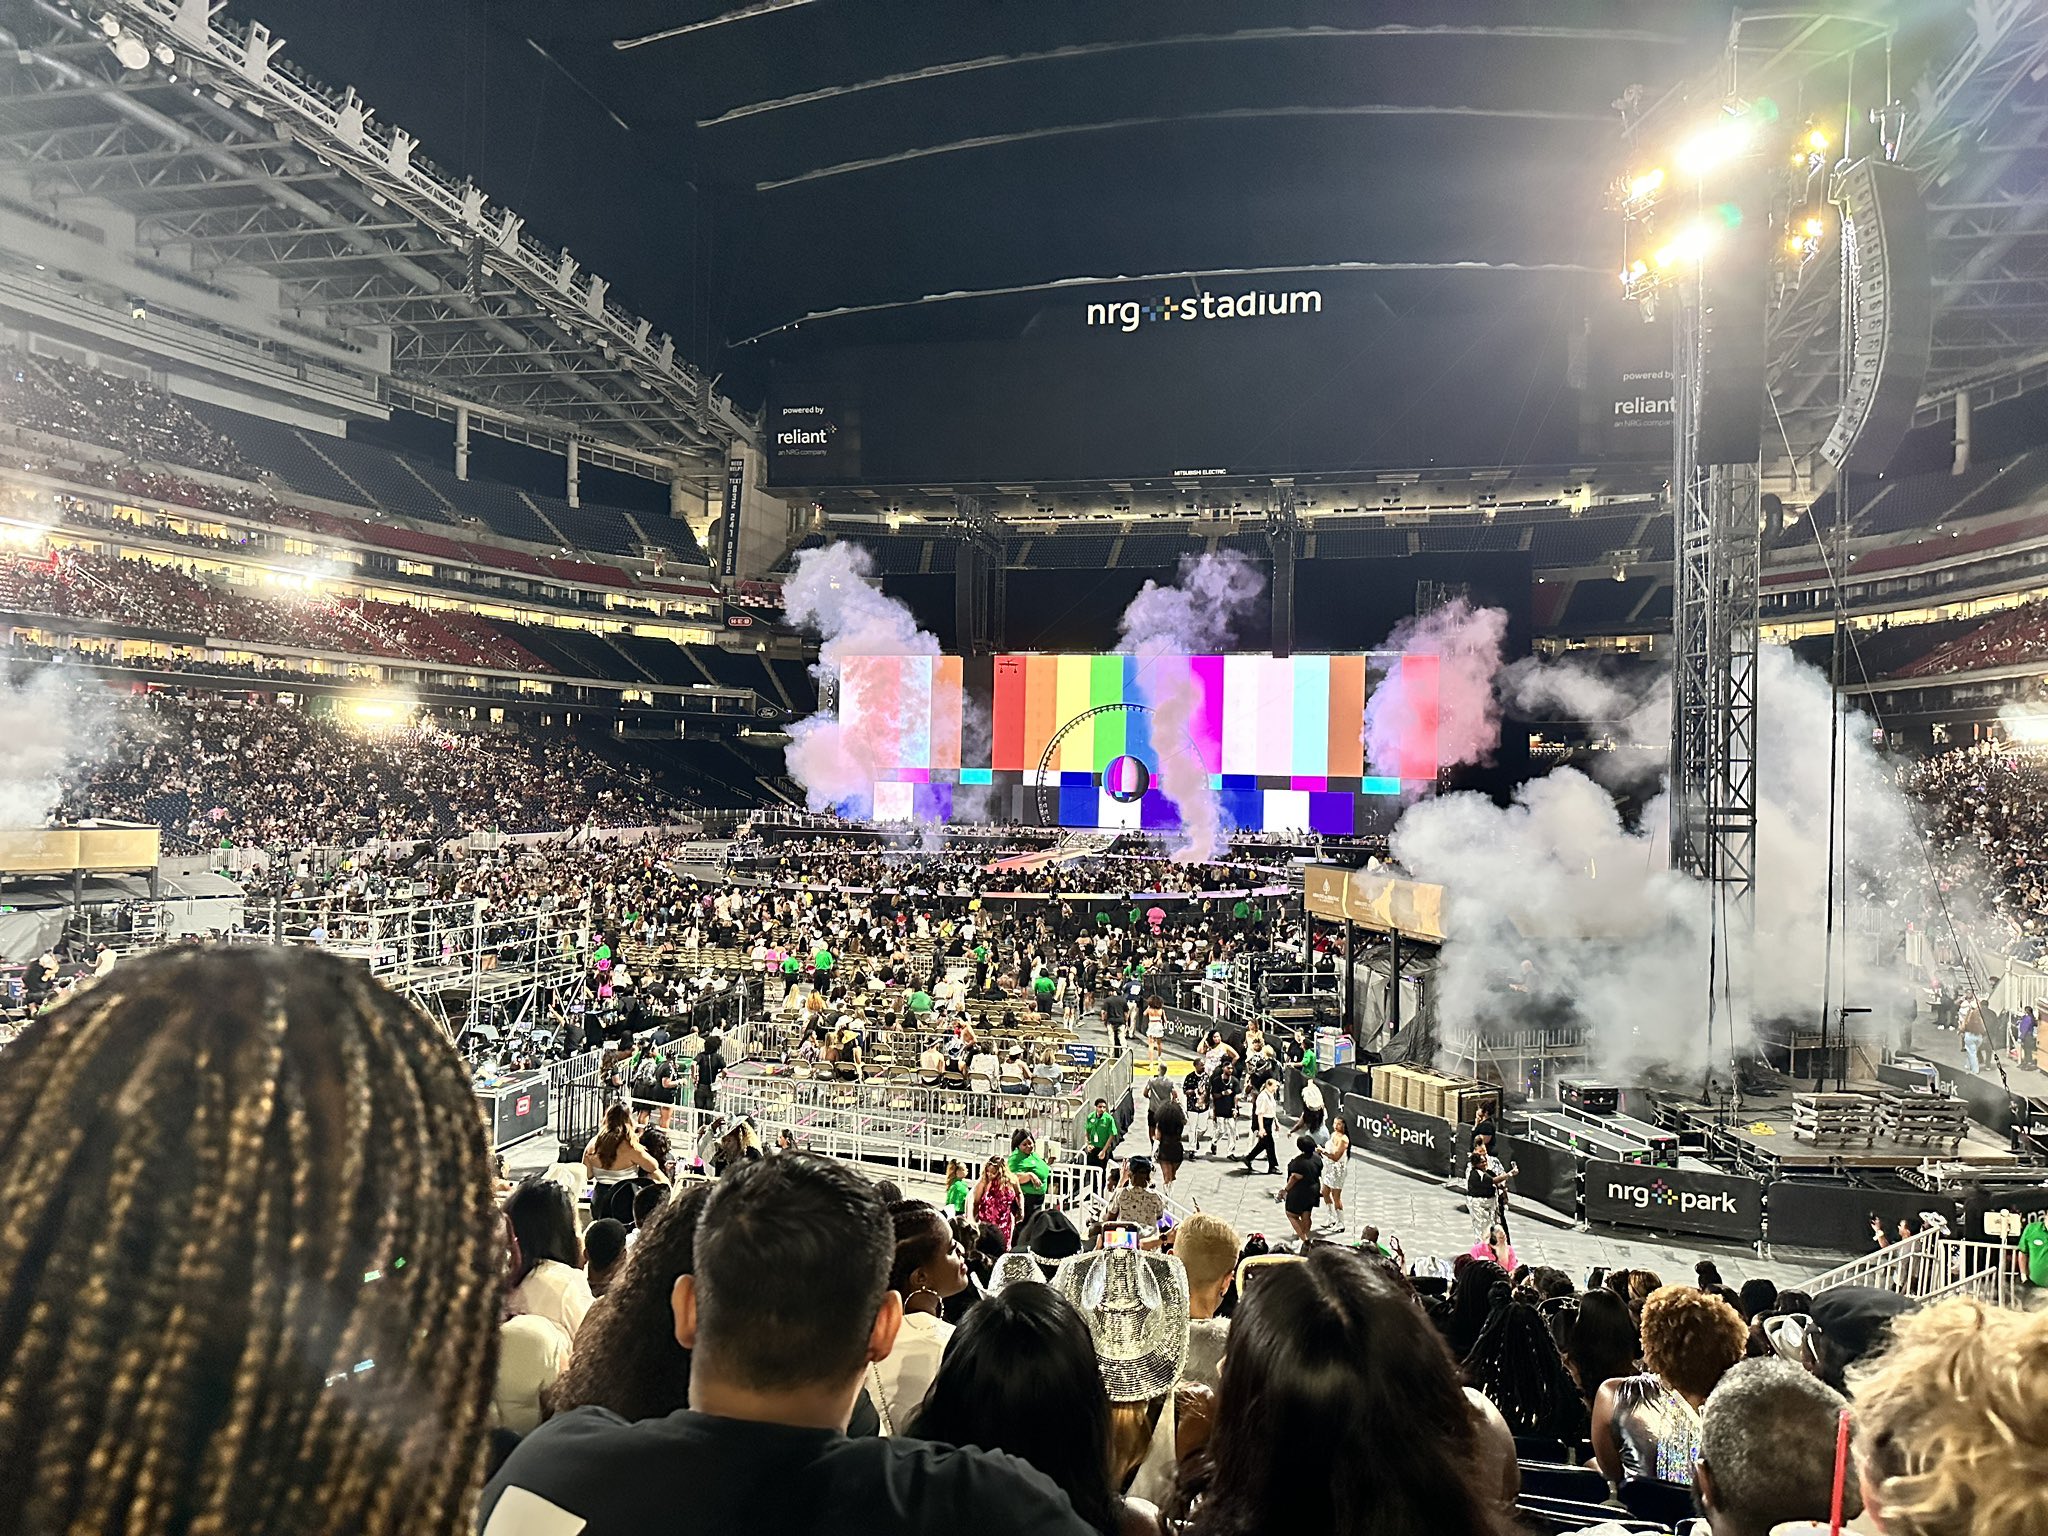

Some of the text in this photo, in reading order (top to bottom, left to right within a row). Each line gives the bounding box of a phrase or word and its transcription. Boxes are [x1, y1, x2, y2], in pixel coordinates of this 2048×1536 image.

[1087, 290, 1322, 333] nrg stadium
[1623, 370, 1664, 382] powered
[782, 406, 825, 416] powered by
[1614, 396, 1676, 415] reliant
[777, 428, 828, 444] reliant
[725, 541, 733, 574] 0202
[735, 985, 744, 994] 12
[1184, 1024, 1204, 1038] park
[1940, 1079, 1959, 1096] ark
[1356, 1114, 1435, 1149] nrg park
[1608, 1183, 1738, 1214] nrg park
